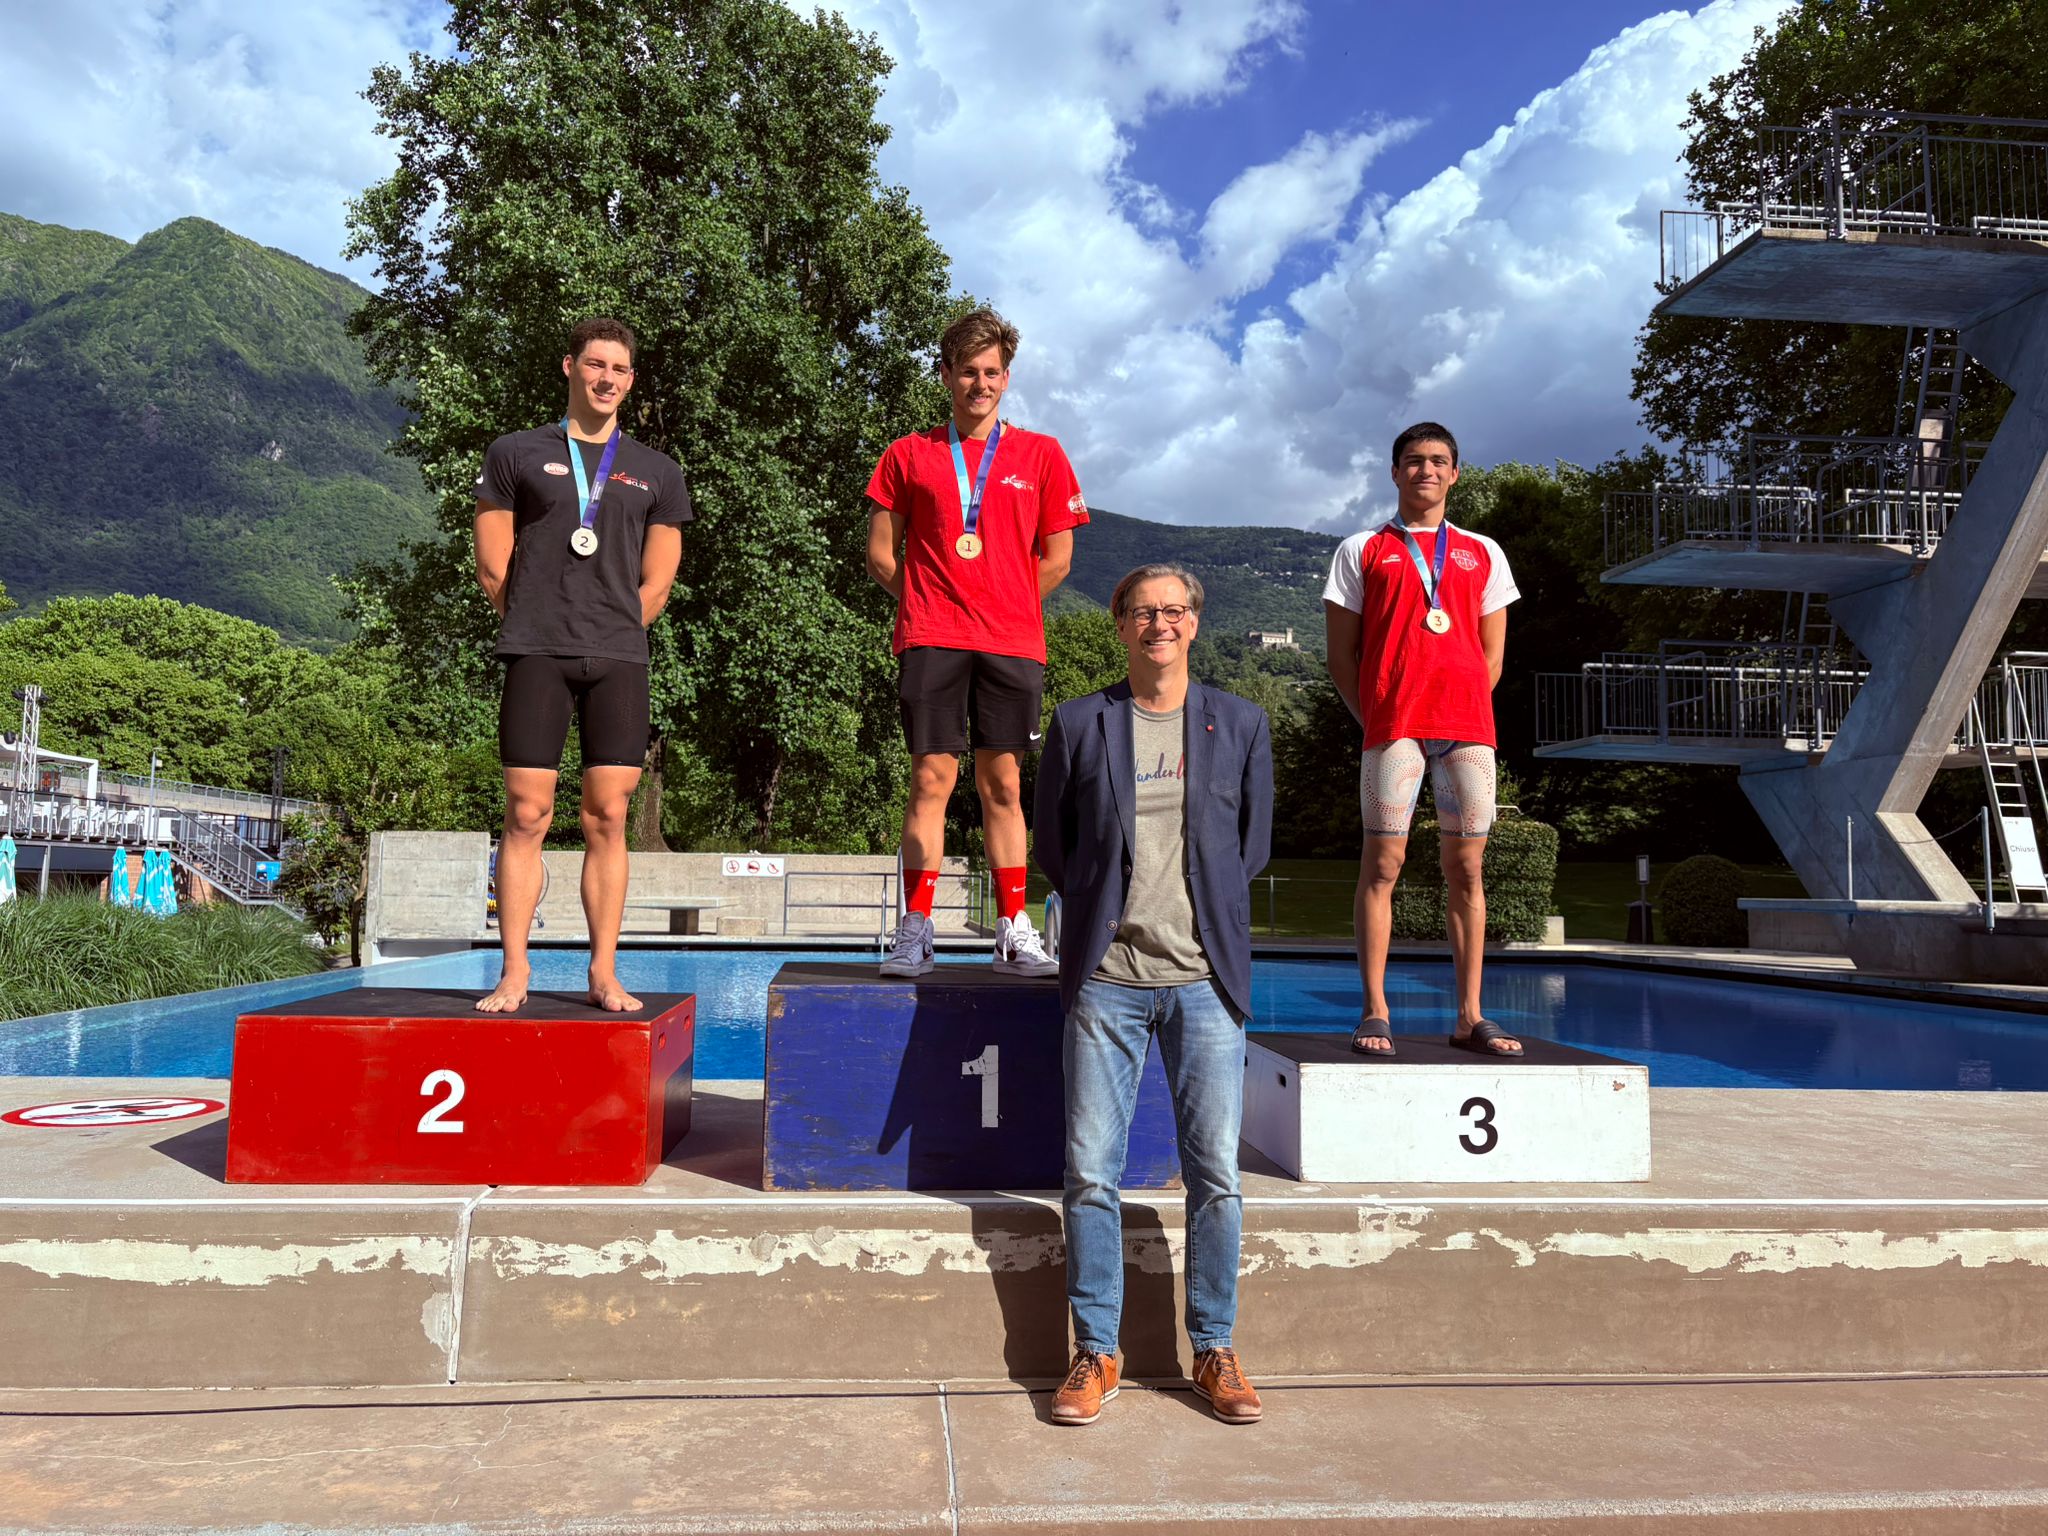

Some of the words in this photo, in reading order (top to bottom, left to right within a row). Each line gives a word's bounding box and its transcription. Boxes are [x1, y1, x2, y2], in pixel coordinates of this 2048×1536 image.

[580, 536, 589, 548] 2
[964, 540, 972, 552] 1
[1435, 615, 1442, 627] 3
[416, 1068, 466, 1133] 2
[961, 1044, 999, 1129] 1
[1458, 1096, 1499, 1155] 3
